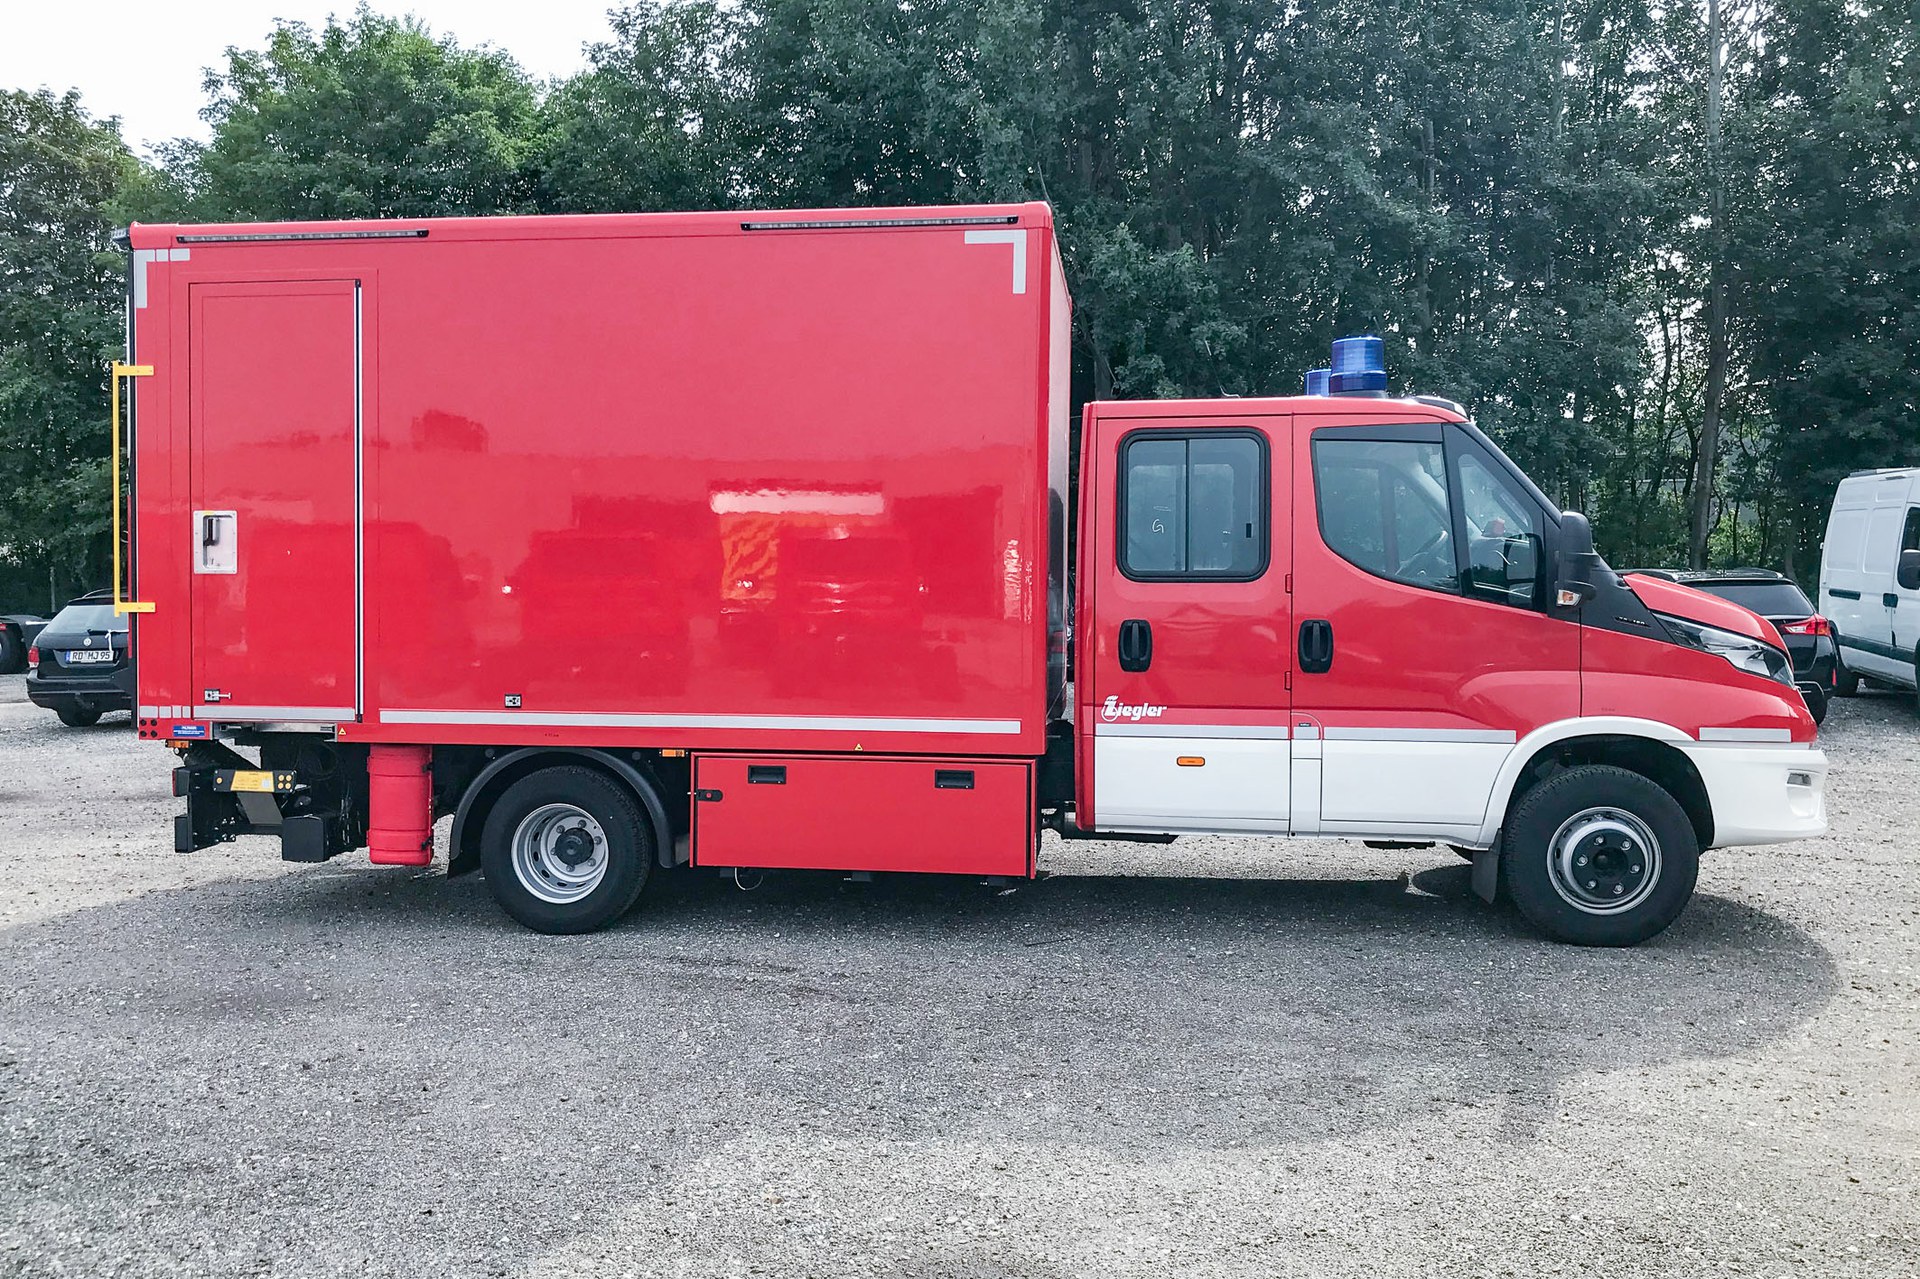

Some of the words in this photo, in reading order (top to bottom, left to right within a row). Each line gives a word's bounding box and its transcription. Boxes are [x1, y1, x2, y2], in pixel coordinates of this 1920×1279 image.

[72, 651, 83, 660] RD
[100, 651, 110, 660] 95
[1101, 695, 1168, 722] Ziegler
